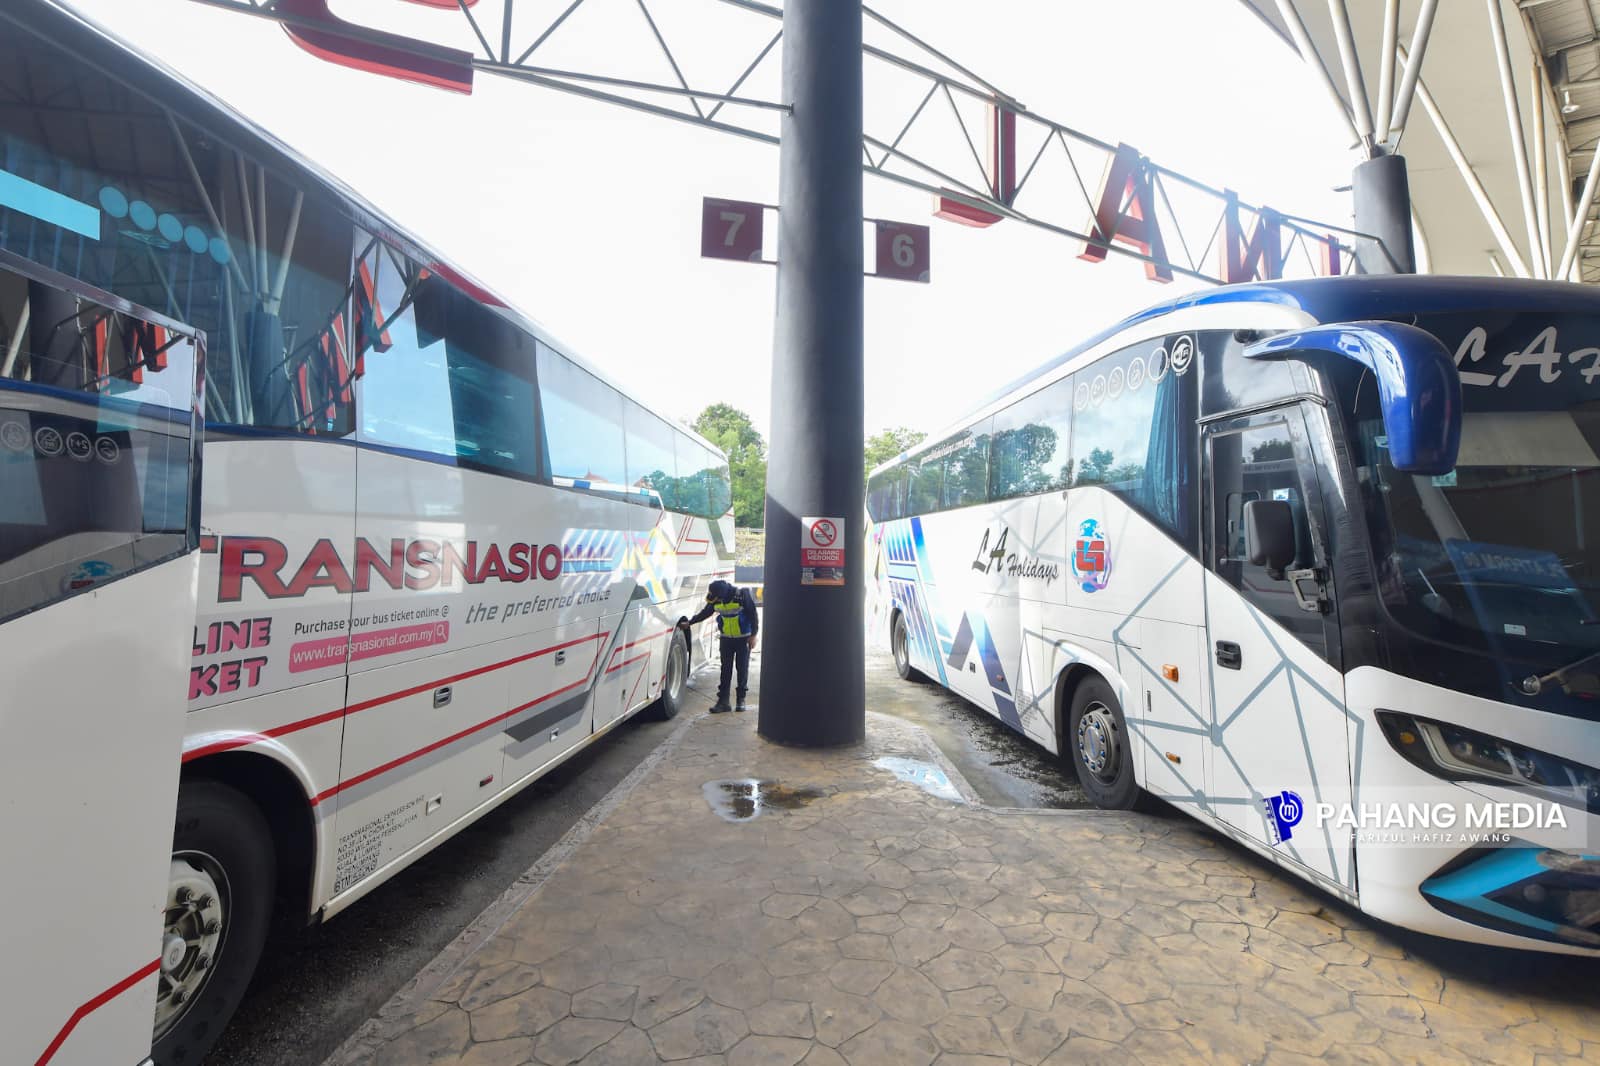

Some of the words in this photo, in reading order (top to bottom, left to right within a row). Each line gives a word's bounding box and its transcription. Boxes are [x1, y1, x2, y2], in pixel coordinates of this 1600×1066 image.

[719, 211, 746, 247] 7
[892, 233, 915, 267] 6
[972, 526, 1009, 575] LA
[1007, 553, 1059, 584] Holidays
[294, 620, 345, 635] Purchase
[348, 616, 370, 631] your
[372, 613, 389, 625] bus
[390, 610, 414, 622] ticket
[415, 607, 440, 619] online
[441, 605, 449, 618] @
[465, 602, 499, 624] the
[501, 592, 576, 623] preferred
[577, 589, 611, 606] choice
[293, 628, 434, 665] www.transnasional.com.my
[188, 656, 268, 700] KET
